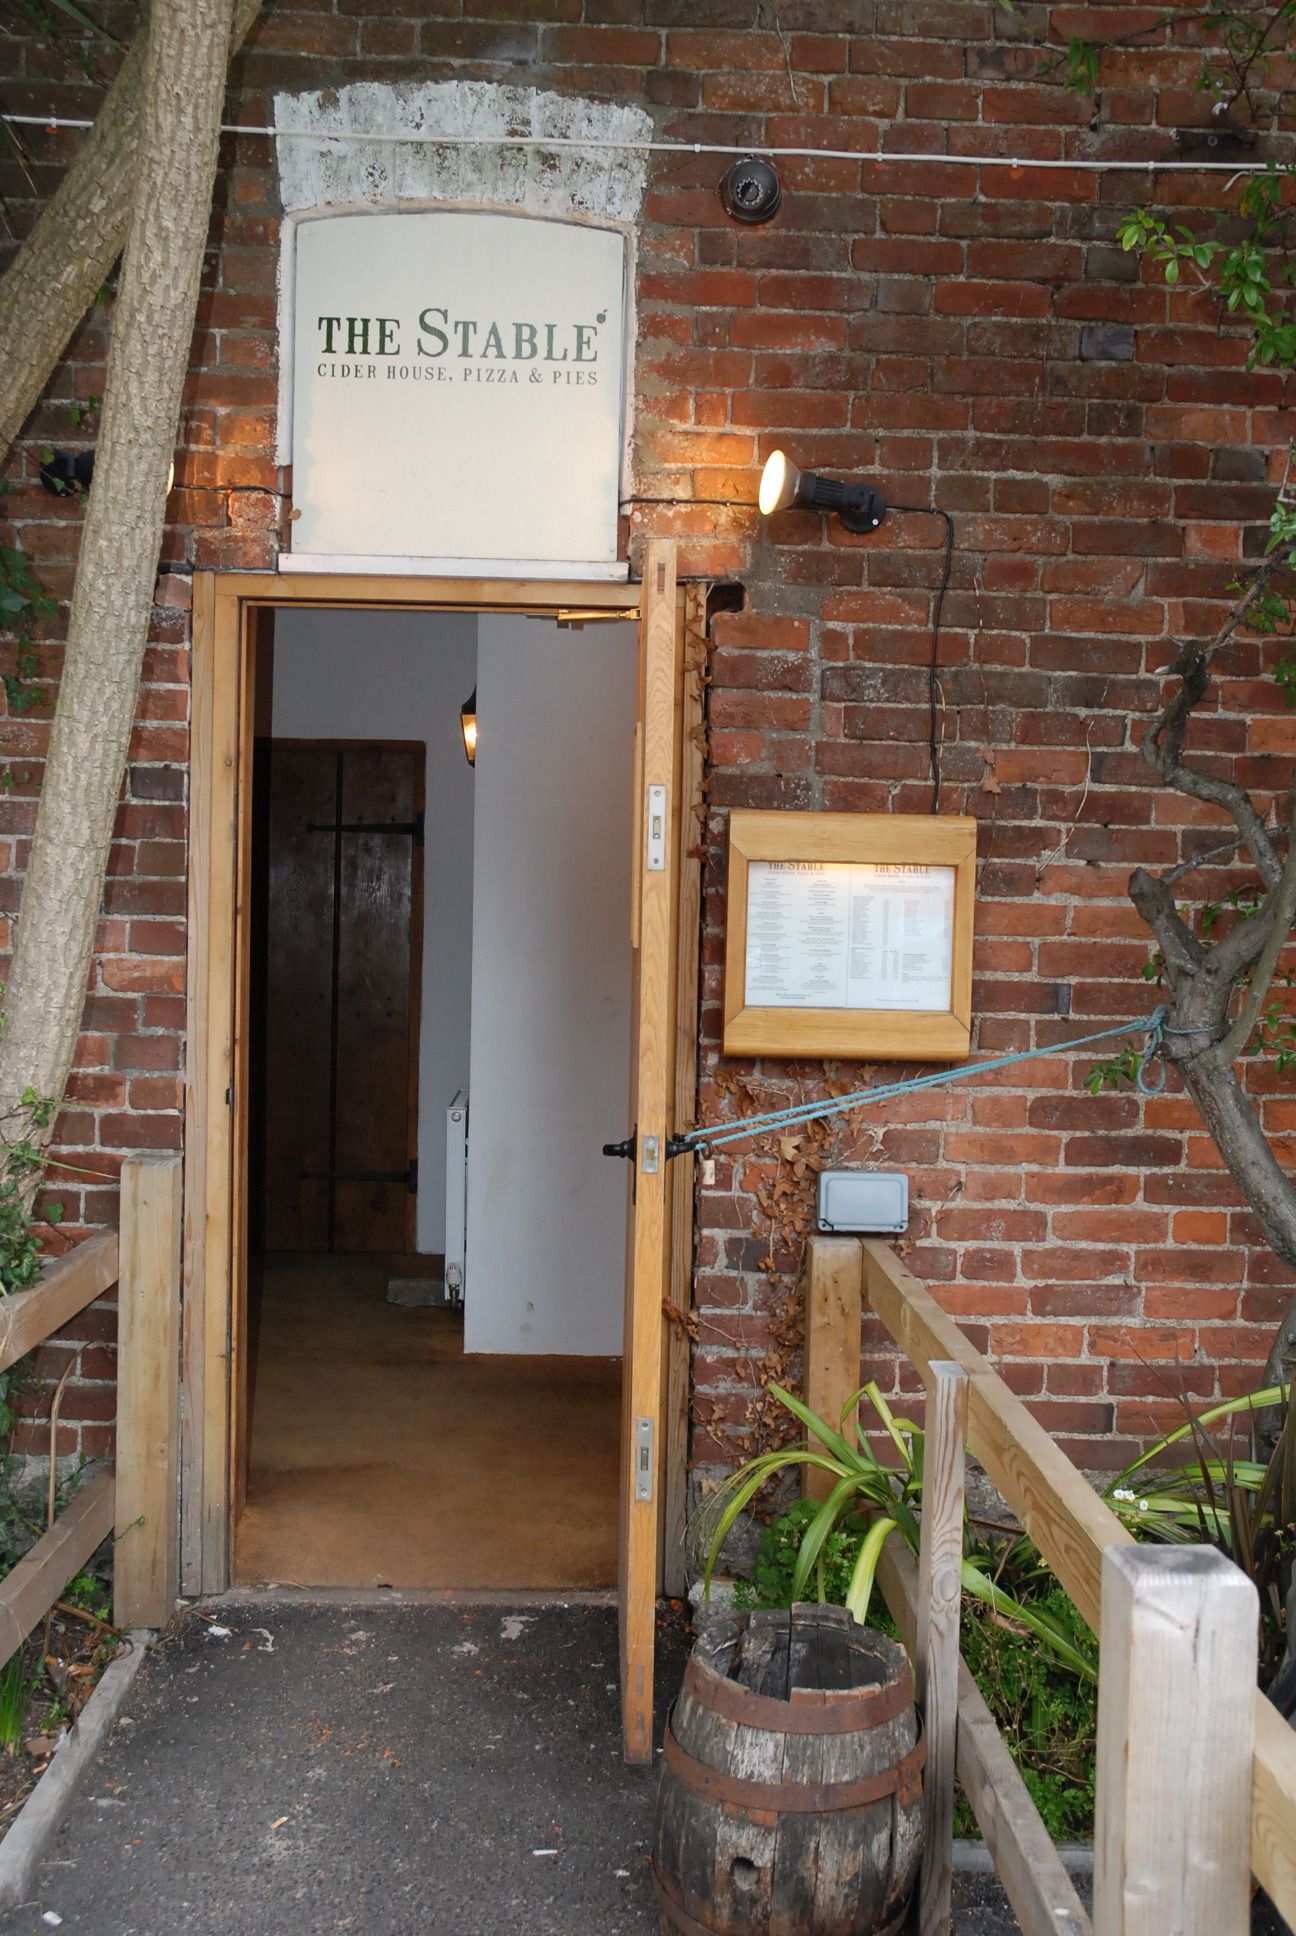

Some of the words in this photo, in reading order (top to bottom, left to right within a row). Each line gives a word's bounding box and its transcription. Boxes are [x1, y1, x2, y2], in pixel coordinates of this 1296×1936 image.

[318, 316, 400, 356] THE
[417, 308, 598, 362] STABLE
[317, 363, 377, 379] CIDER
[387, 365, 453, 383] HOUSE,
[463, 367, 519, 383] PIZZA
[528, 367, 544, 383] &
[552, 370, 598, 385] PIES
[769, 862, 786, 870] THE
[874, 864, 890, 873] THE
